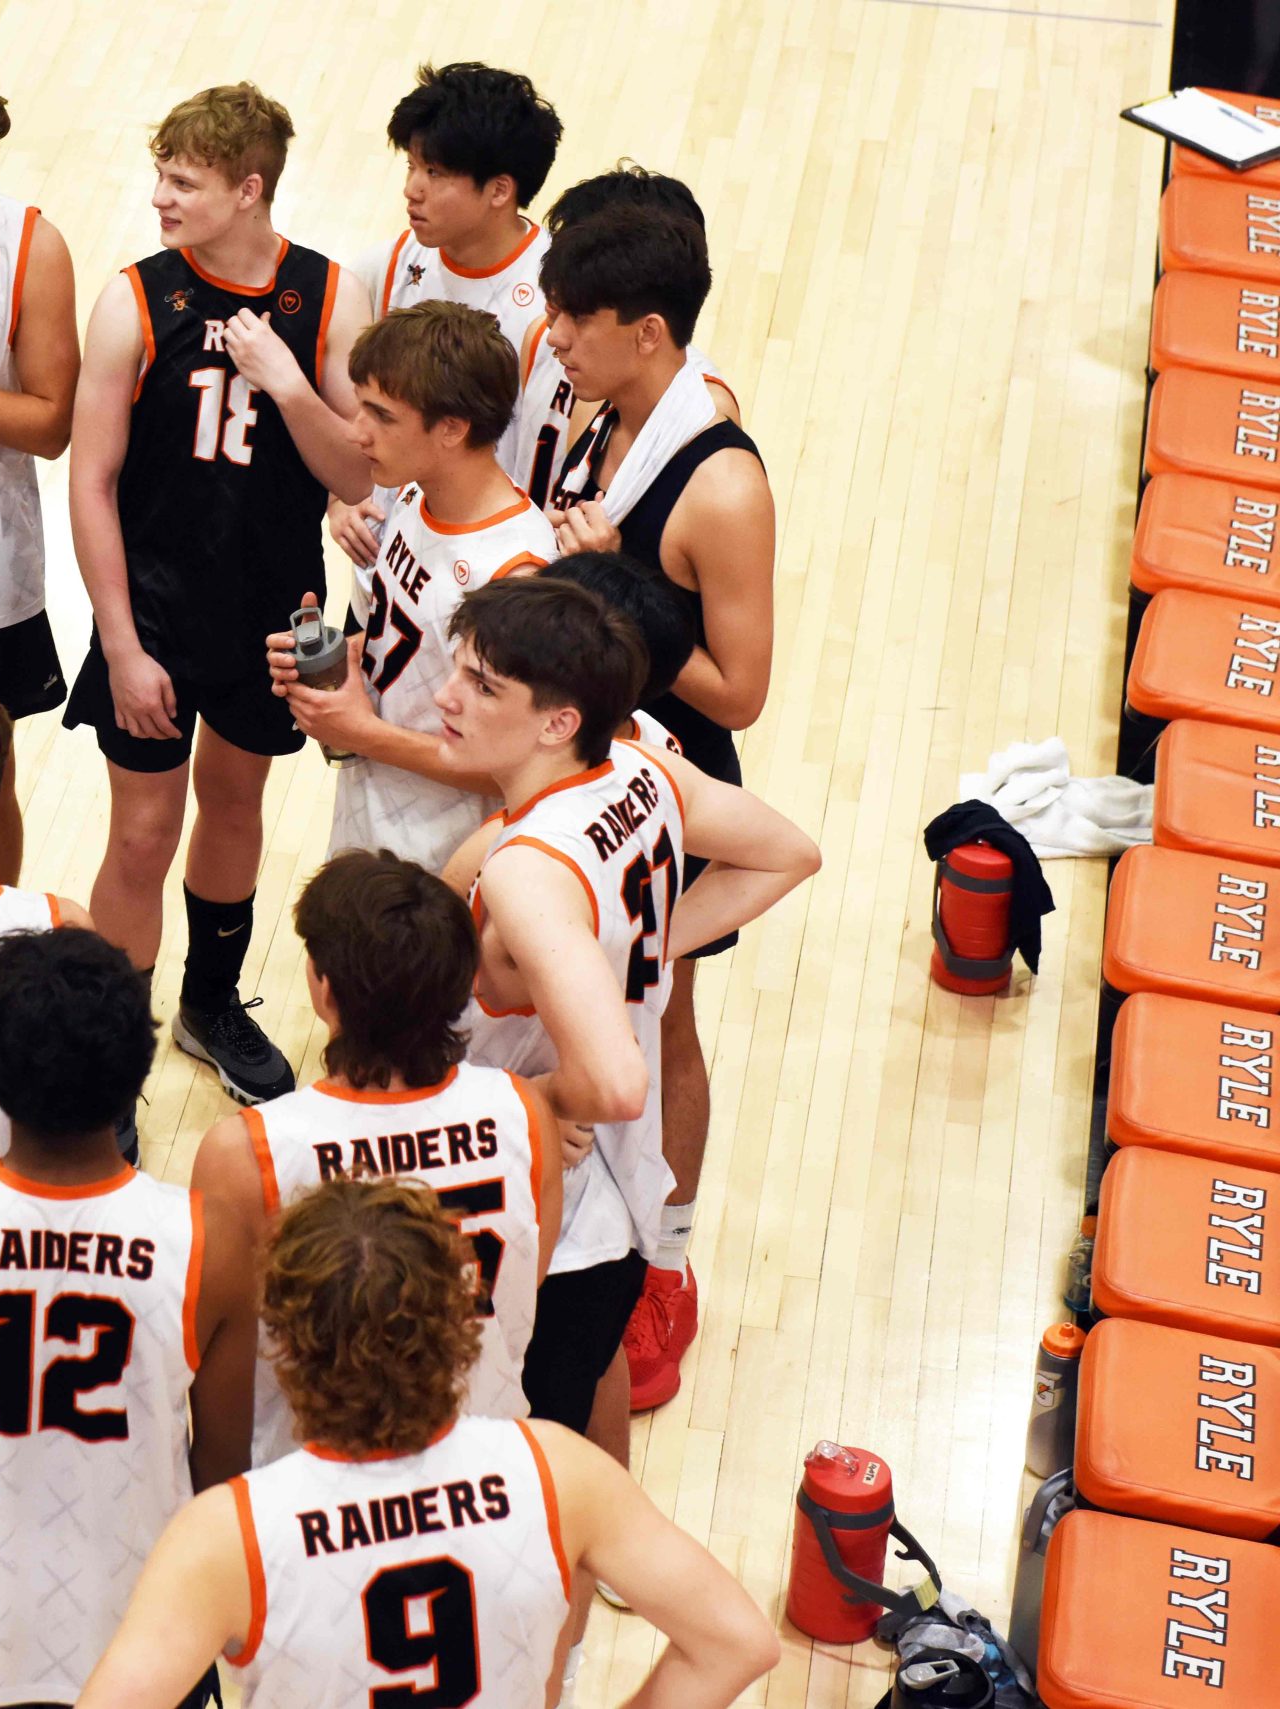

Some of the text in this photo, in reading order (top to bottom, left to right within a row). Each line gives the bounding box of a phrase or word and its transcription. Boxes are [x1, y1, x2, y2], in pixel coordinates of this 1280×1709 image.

[1238, 290, 1279, 358] RYLE
[1234, 390, 1280, 462] RYLE
[386, 529, 431, 605] RYLE
[1224, 497, 1278, 574] RYLE
[1226, 613, 1280, 696] RYLE
[1210, 873, 1267, 970] RYLE
[1217, 1022, 1273, 1128] RYLE
[313, 1118, 499, 1181] RAIDERS
[1206, 1179, 1266, 1294] RYLE
[1196, 1353, 1256, 1481] RYLE
[295, 1475, 512, 1557] RAIDERS
[361, 1555, 484, 1709] 9
[1161, 1547, 1230, 1689] RYLE
